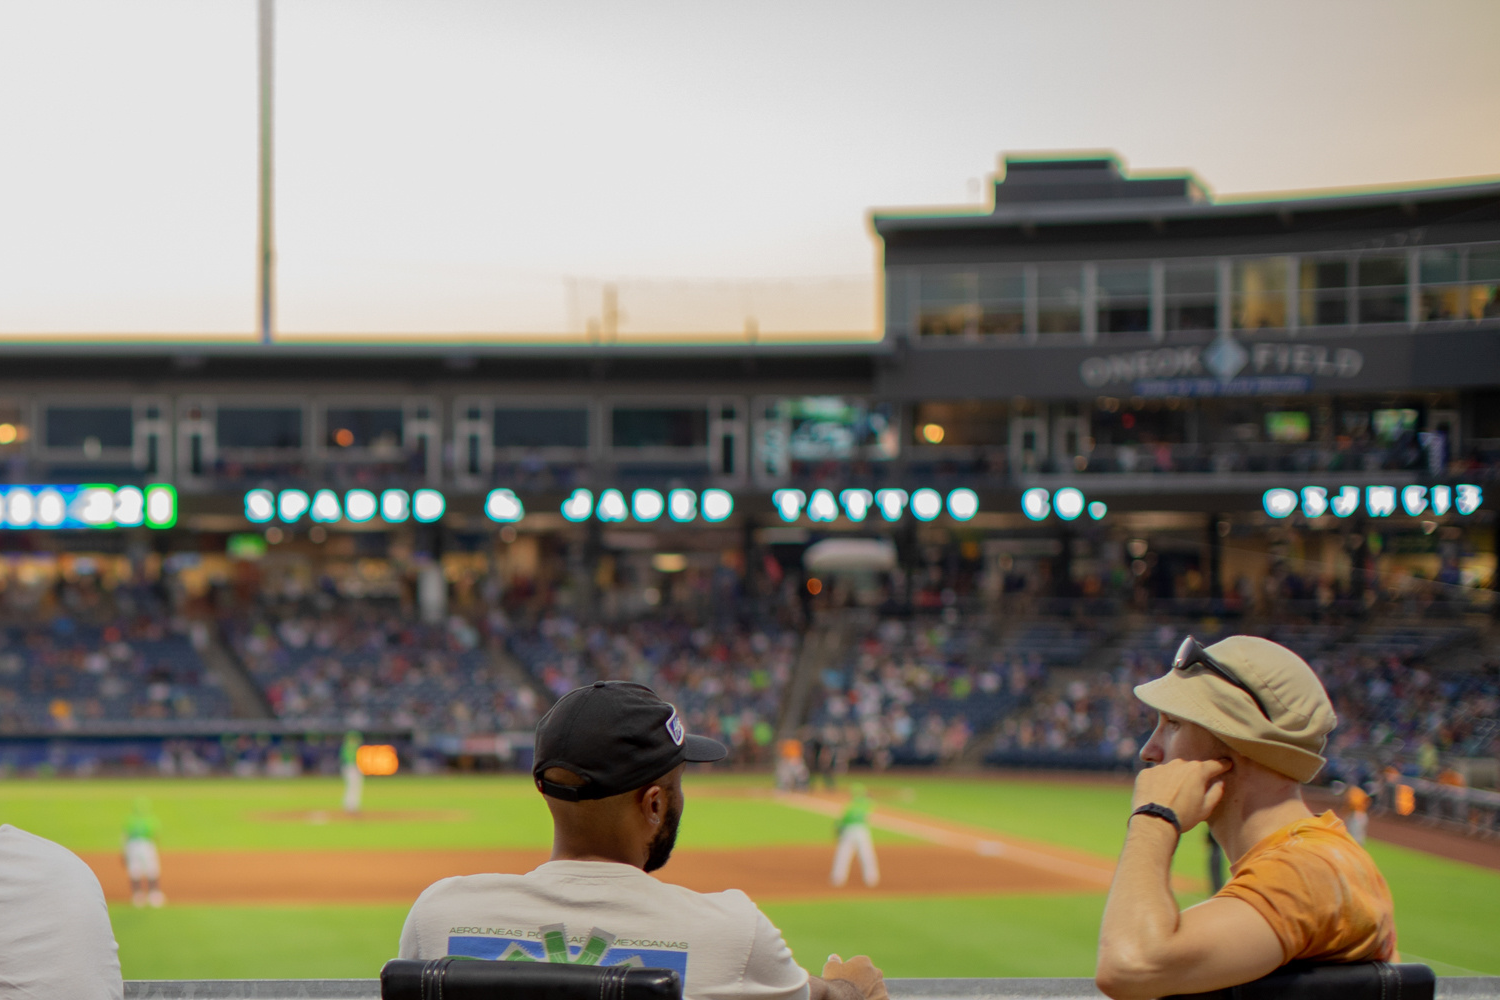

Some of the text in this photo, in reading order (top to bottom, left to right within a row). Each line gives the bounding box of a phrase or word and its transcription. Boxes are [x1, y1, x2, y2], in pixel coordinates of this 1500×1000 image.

[1080, 346, 1199, 388] ONEOK
[1254, 342, 1364, 378] FIELD
[772, 487, 979, 523] TATTOO
[449, 926, 523, 937] AEROLINEAS
[612, 938, 689, 950] MEXICANAS
